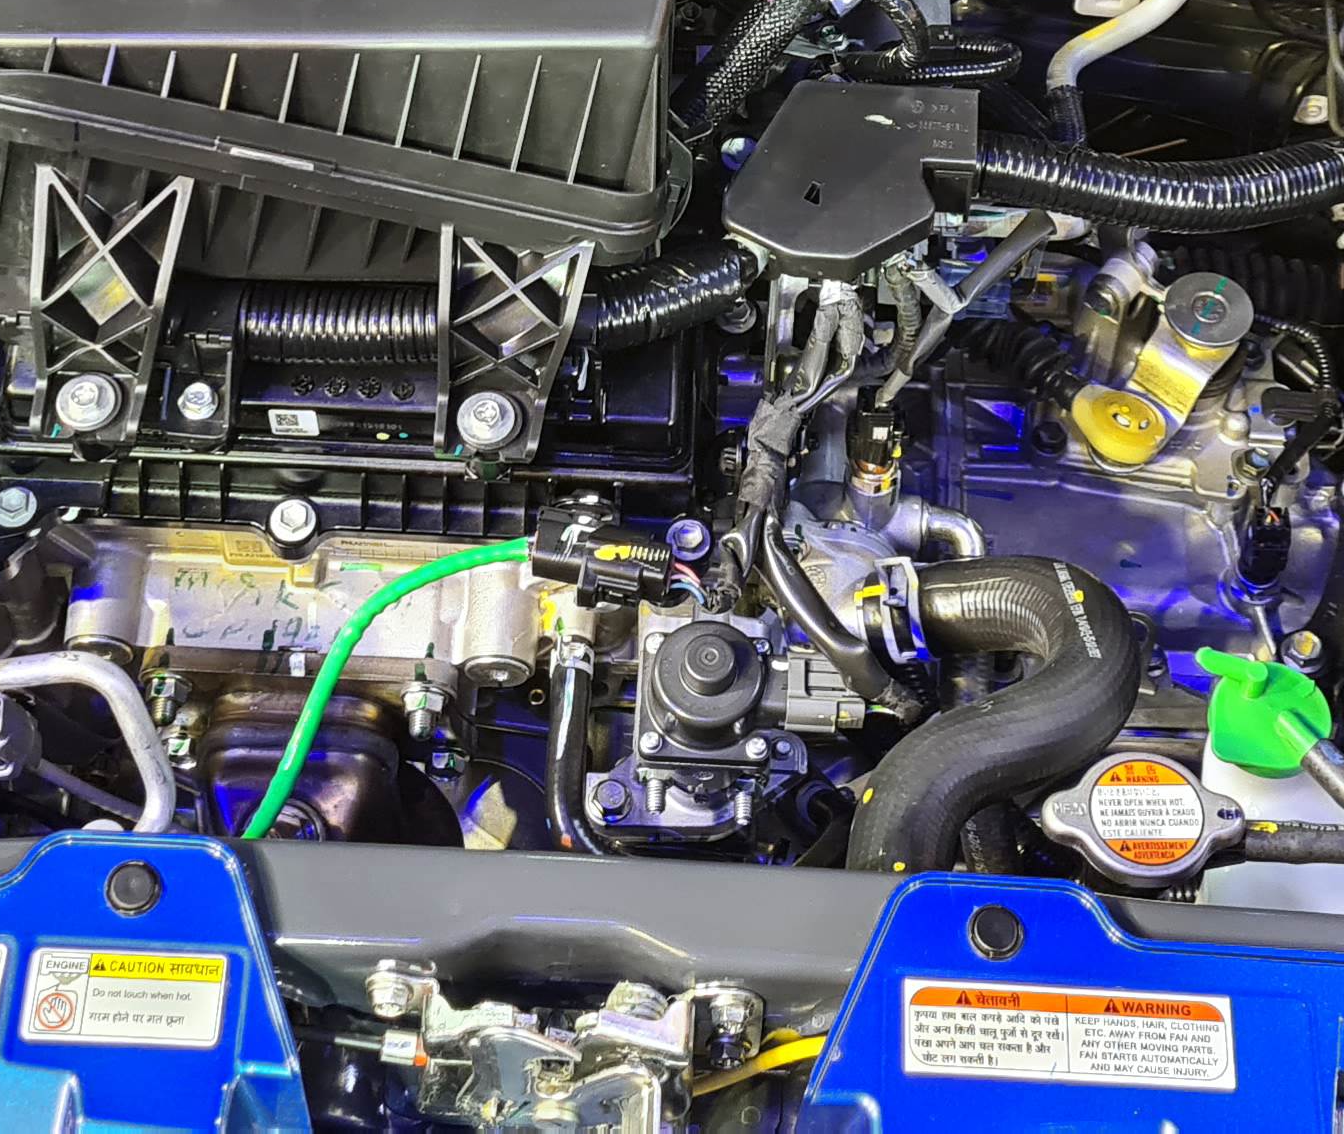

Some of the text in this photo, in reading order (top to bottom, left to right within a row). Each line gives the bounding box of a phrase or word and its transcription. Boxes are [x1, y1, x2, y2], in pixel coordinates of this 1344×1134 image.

[46, 960, 86, 971] ENGINE
[109, 960, 220, 976] CAUTION सावधान
[92, 988, 106, 998] Do
[107, 988, 122, 998] not
[123, 989, 148, 1000] touch
[975, 992, 1021, 1007] चेतावनी
[1122, 1001, 1192, 1016] WARNING
[1074, 1016, 1100, 1026] KEEP
[1170, 1022, 1220, 1033] CLOTHING
[1108, 1029, 1136, 1039] AWAY
[1138, 1031, 1166, 1041] FROM
[1170, 1033, 1188, 1042] FAN
[1191, 1034, 1211, 1043] AND
[1081, 1039, 1100, 1048] ANY
[1104, 1040, 1137, 1050] OTHER
[1140, 1042, 1179, 1053] MOVING
[1079, 1050, 1098, 1059] FAN
[1141, 1054, 1219, 1066] AUTOMATICALLY
[1090, 1063, 1111, 1071] AND
[1114, 1064, 1133, 1073] MAY
[1137, 1065, 1170, 1075] CAUSE
